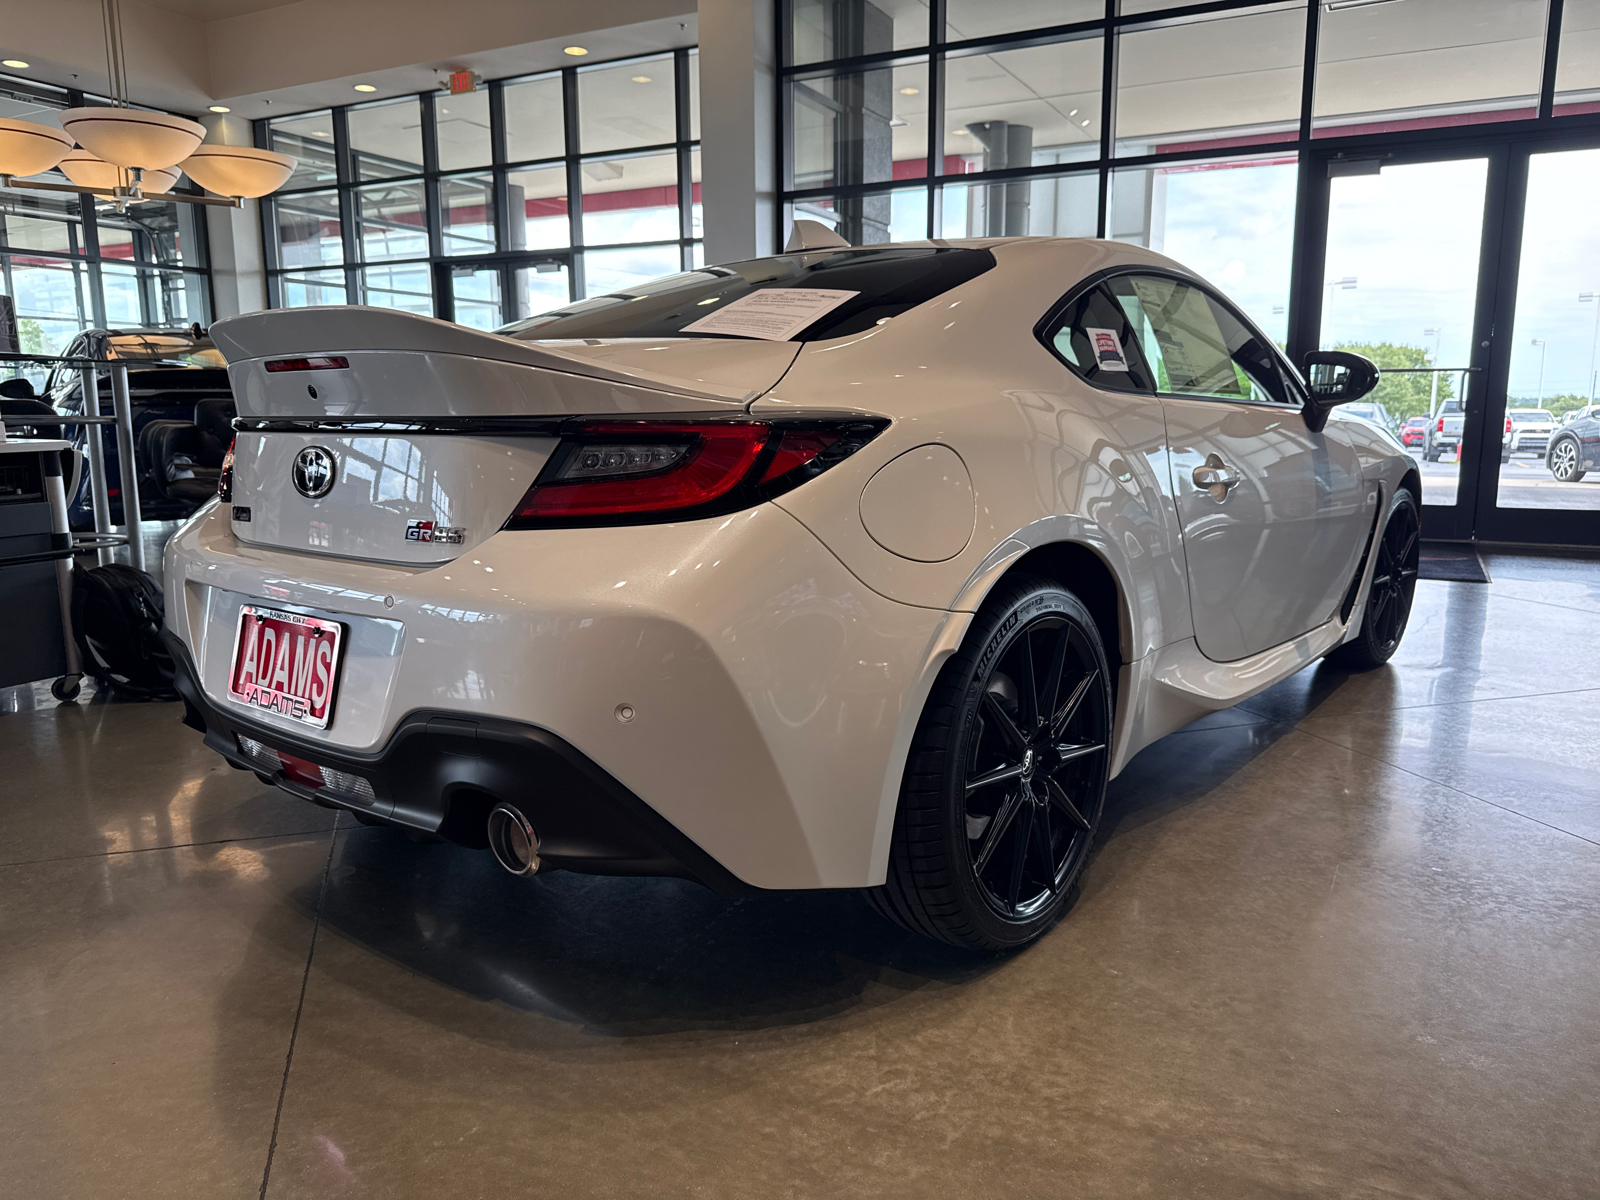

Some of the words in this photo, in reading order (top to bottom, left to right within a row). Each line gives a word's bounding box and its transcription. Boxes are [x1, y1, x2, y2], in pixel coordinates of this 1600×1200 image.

[453, 72, 469, 91] EXIT
[269, 611, 291, 621] KANSAS
[293, 614, 306, 624] CITY
[977, 614, 1018, 678] MICHELIN
[239, 624, 331, 709] ADAMS
[249, 688, 305, 719] ADAMS
